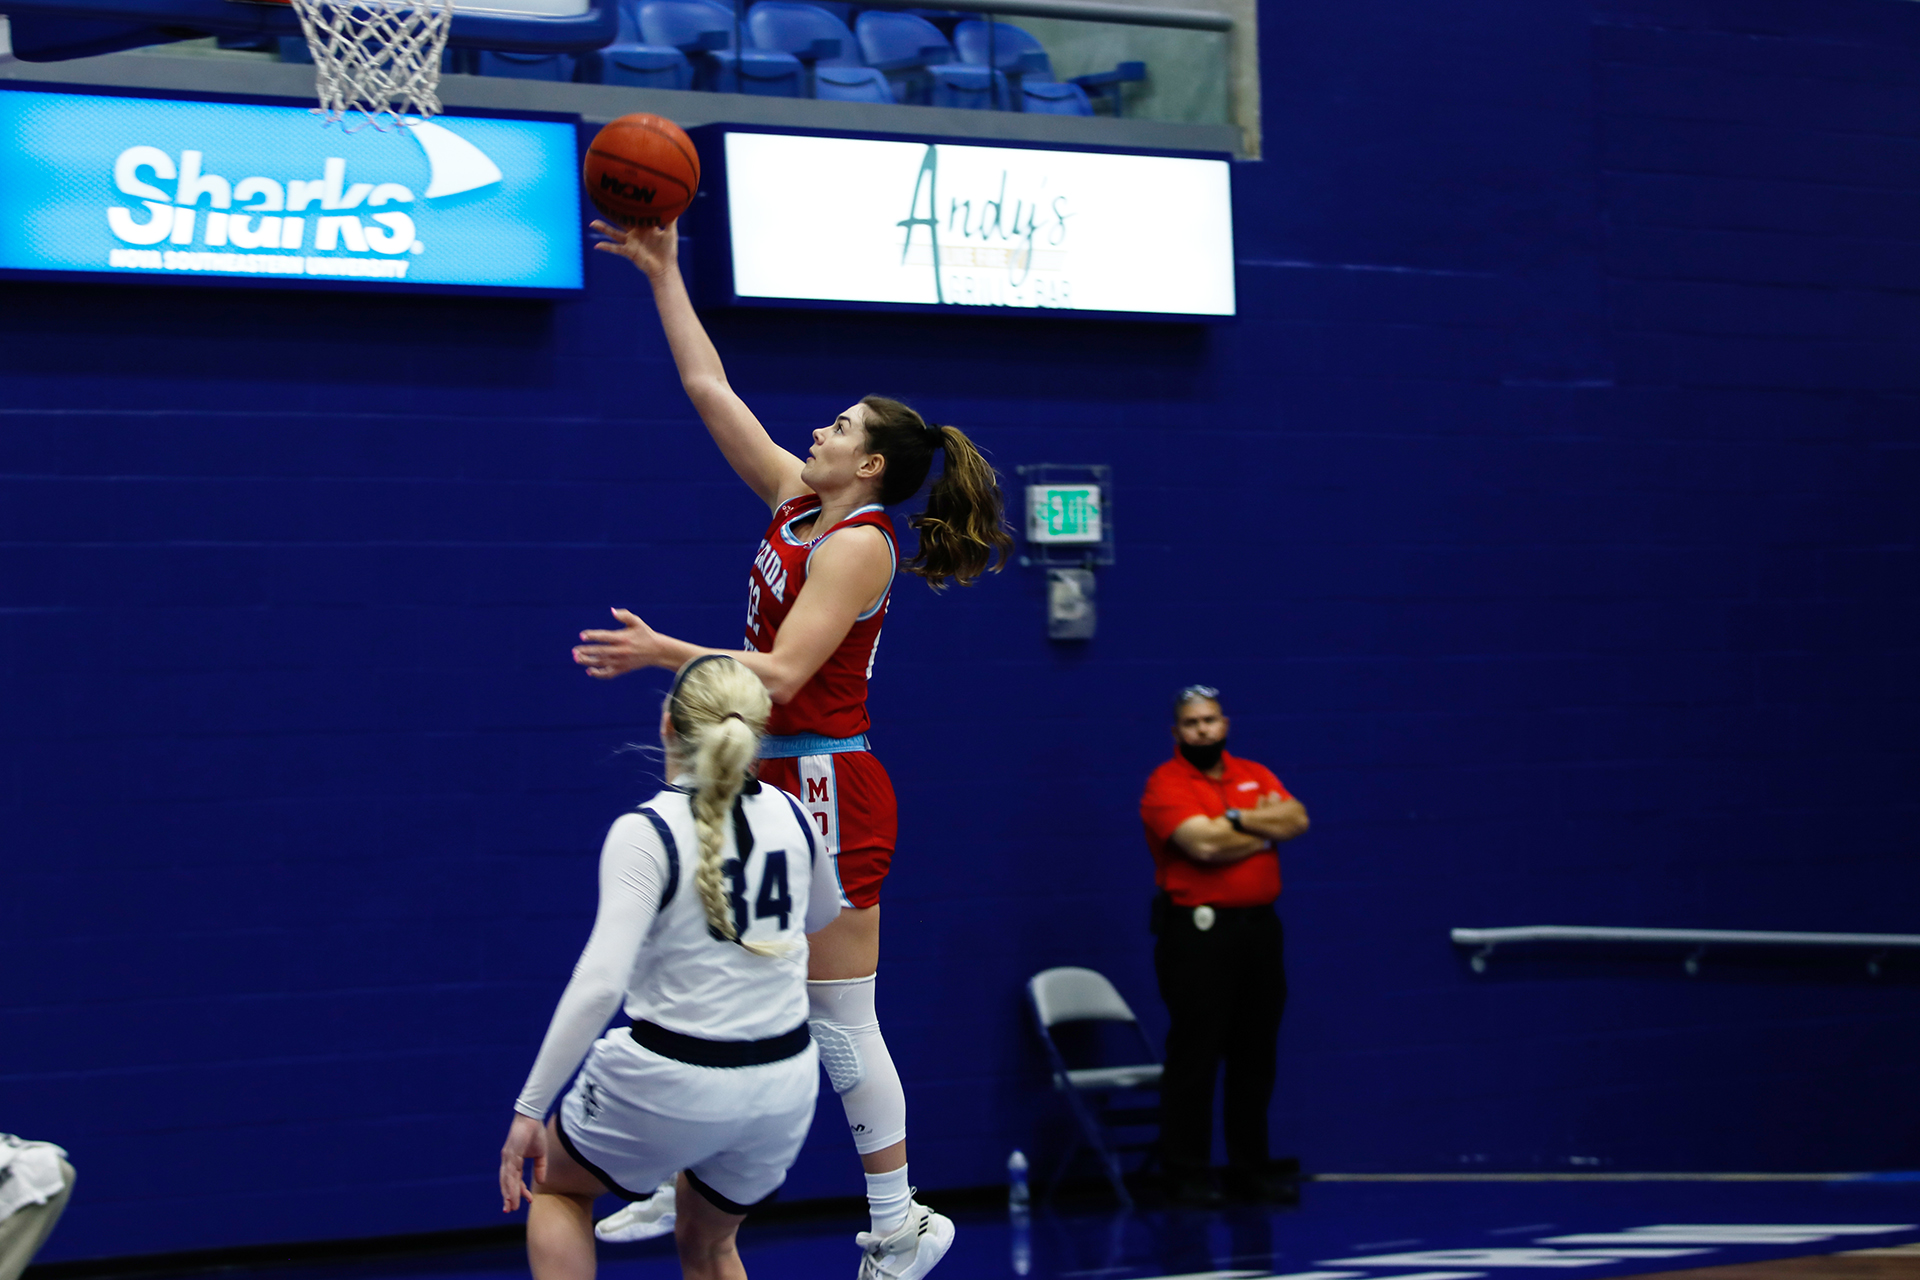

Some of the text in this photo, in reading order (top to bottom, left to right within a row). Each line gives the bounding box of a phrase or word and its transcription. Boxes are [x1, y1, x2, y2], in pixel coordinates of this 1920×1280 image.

[107, 145, 416, 255] Sharks
[896, 143, 1077, 304] Andy's
[806, 776, 830, 853] MO
[707, 850, 792, 943] 34
